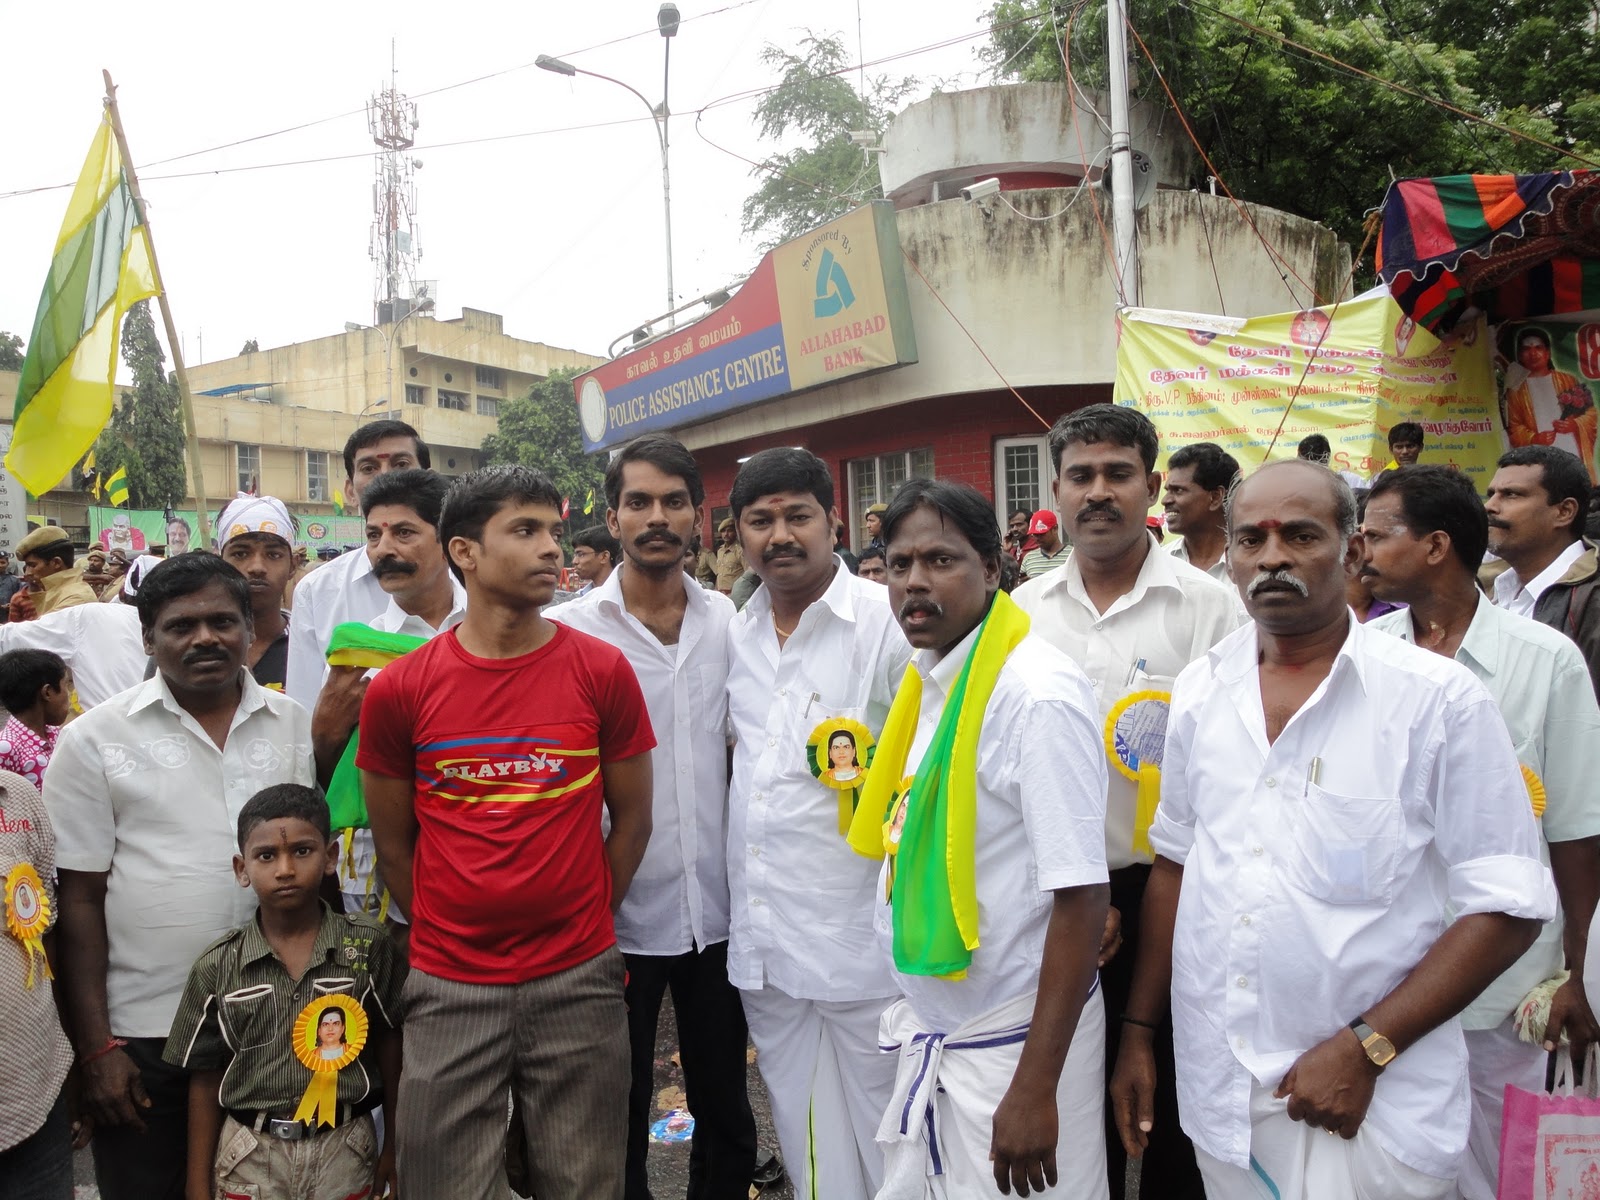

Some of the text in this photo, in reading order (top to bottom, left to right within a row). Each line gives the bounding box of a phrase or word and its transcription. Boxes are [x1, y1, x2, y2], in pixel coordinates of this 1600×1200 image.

[801, 229, 853, 271] Sponsored By
[626, 315, 742, 379] காவல் உதவி மையம்
[800, 314, 886, 356] ALLAHABAD
[823, 346, 865, 372] BANK
[1150, 366, 1208, 385] தேவர்
[608, 345, 785, 429] POLICE ASSISTANCE CENTRE
